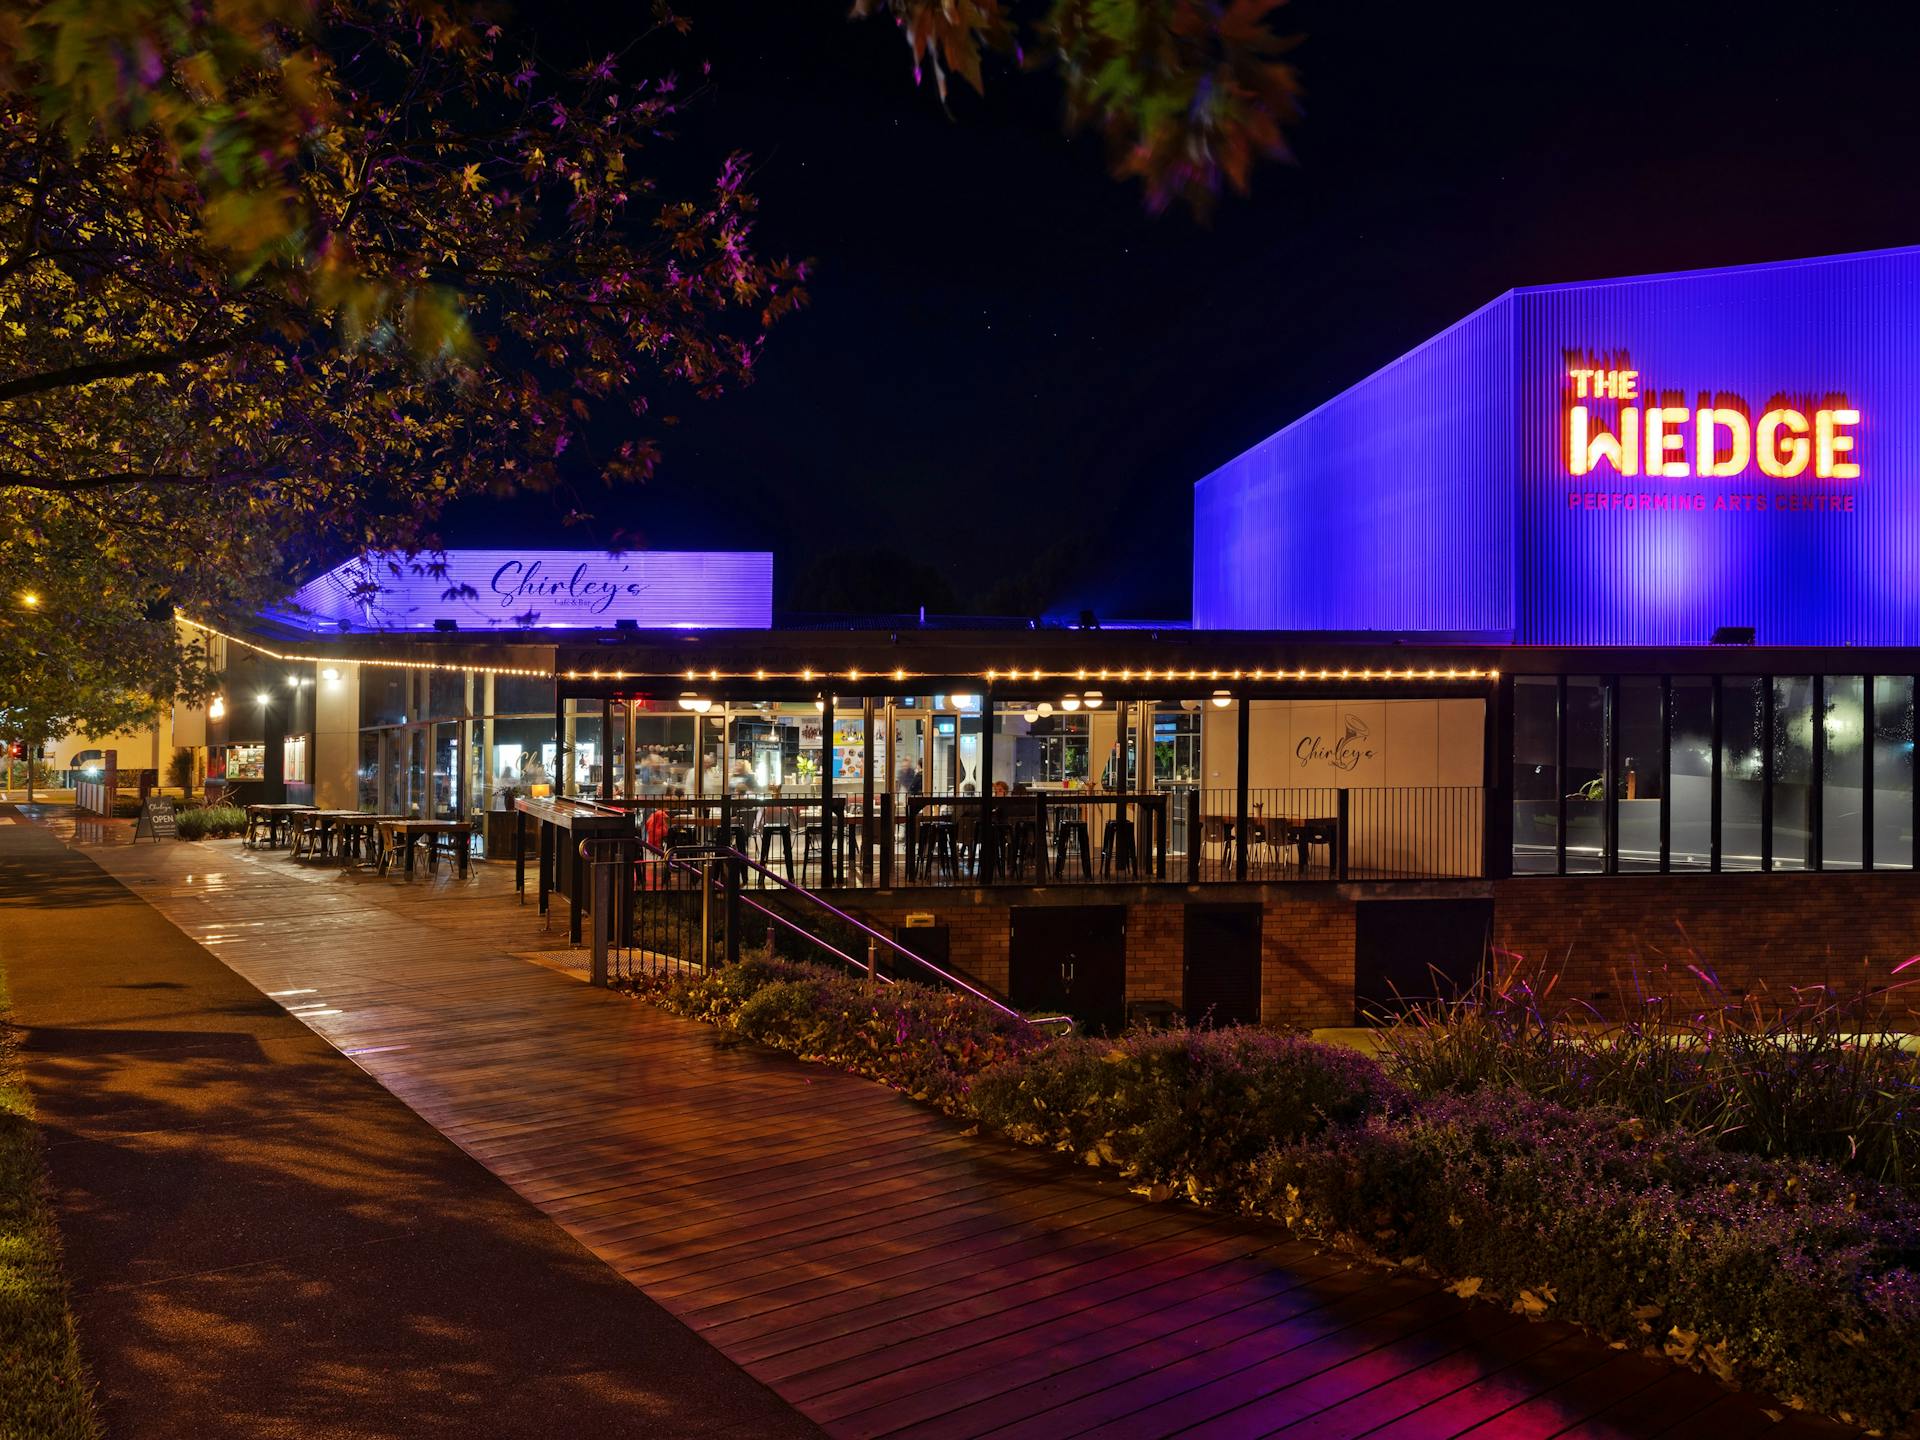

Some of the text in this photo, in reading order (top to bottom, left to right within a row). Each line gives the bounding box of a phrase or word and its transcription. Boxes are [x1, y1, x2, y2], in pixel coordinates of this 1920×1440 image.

[1569, 369, 1639, 399] THE
[1569, 406, 1860, 479] WEDGE
[1568, 494, 1854, 513] PERFORMING ARTS CENTRE
[491, 560, 650, 614] Shirley's
[1296, 736, 1377, 771] Shirley's
[152, 815, 174, 823] OPEN
